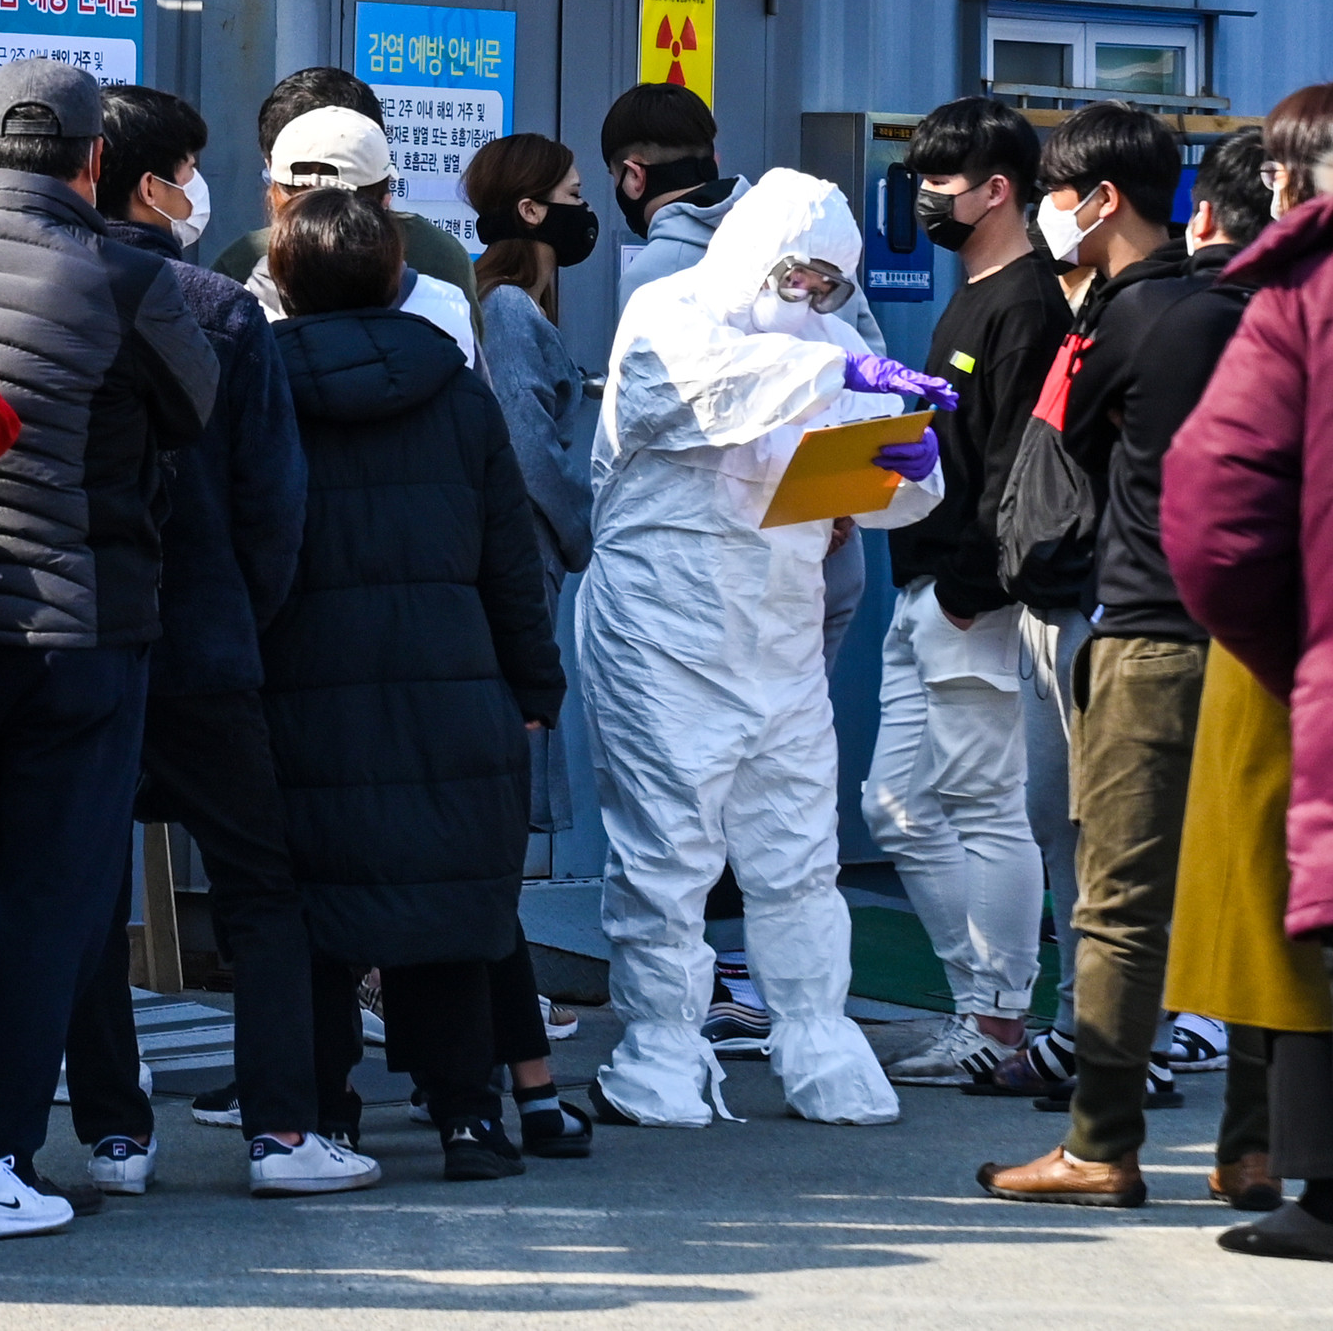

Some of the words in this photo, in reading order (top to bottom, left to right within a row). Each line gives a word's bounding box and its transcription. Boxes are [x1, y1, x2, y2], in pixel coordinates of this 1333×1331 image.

[73, 51, 92, 68] 거주
[94, 51, 103, 71] 및
[368, 32, 404, 73] 감염
[408, 34, 445, 76] 예방
[448, 37, 502, 79] 안내문
[398, 99, 413, 118] 2주
[416, 101, 433, 120] 이내
[436, 101, 453, 121] 해외
[457, 102, 474, 122] 거주
[477, 102, 486, 123] 및
[384, 124, 409, 145] 행자로
[413, 126, 429, 145] 발열
[432, 127, 448, 146] 또는
[450, 127, 496, 148] 호흡기증상자
[403, 152, 439, 175] 호흡곤란,
[443, 153, 462, 175] 발열,
[464, 219, 475, 239] 등)
